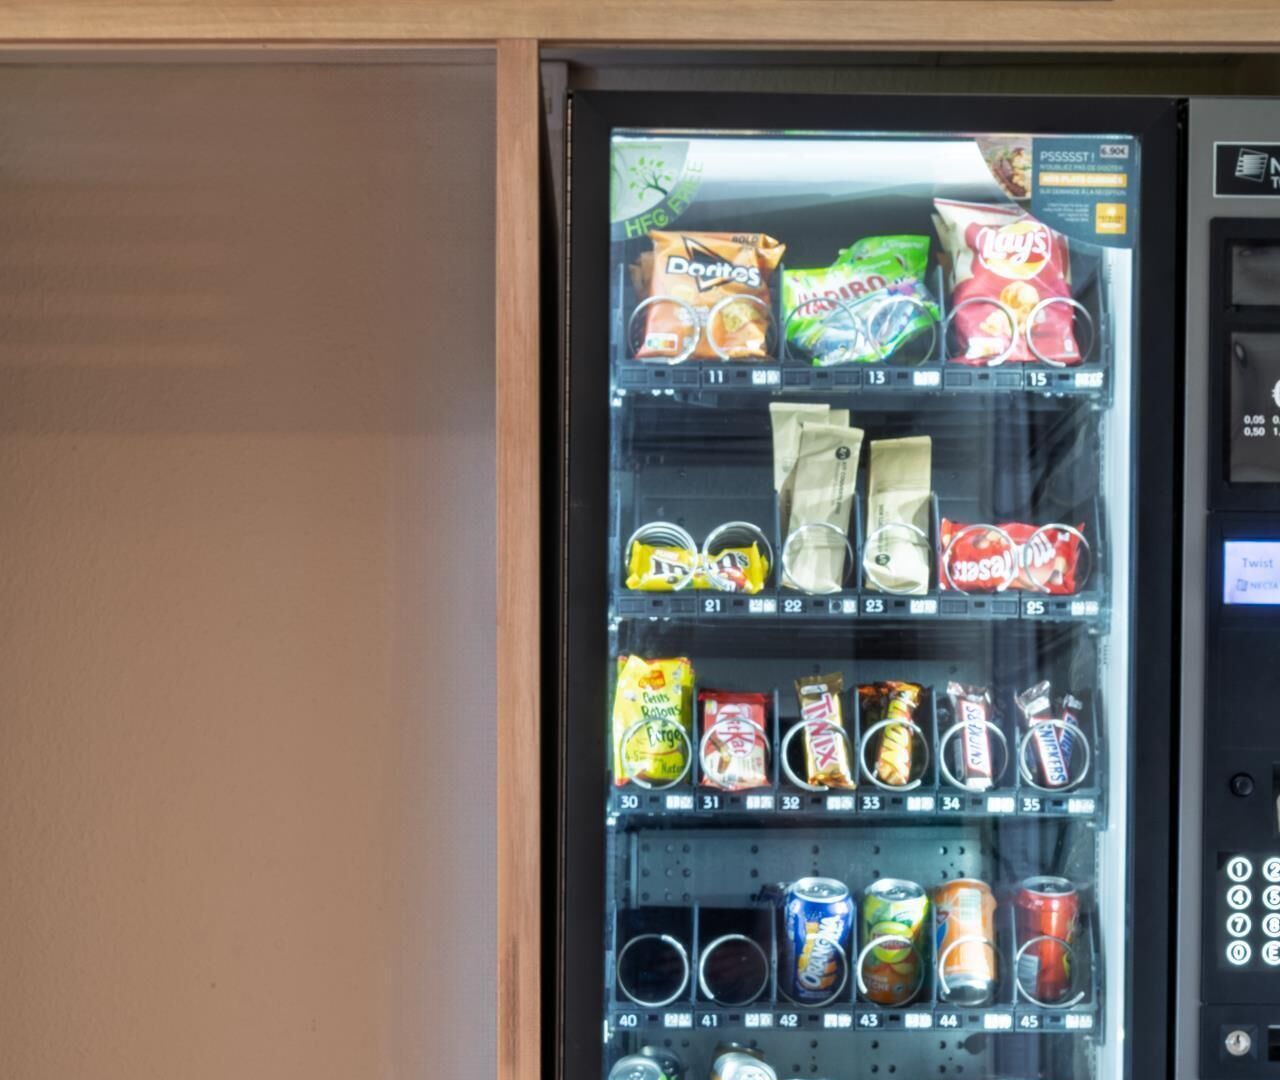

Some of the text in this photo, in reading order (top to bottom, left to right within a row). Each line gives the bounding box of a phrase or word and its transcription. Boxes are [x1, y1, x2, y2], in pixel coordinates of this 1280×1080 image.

[666, 255, 762, 288] Doritos
[796, 274, 887, 316] HARIBO
[709, 369, 723, 384] 11
[869, 370, 886, 385] 13
[1030, 372, 1047, 386] 15
[1242, 558, 1274, 569] Twist
[704, 599, 721, 612] 21
[784, 600, 802, 613] 22
[865, 600, 883, 613] 23
[1027, 601, 1045, 615] 25
[802, 693, 839, 768] TWIX
[621, 795, 638, 809] 30
[703, 795, 719, 809] 31
[782, 796, 800, 810] 32
[863, 796, 880, 810] 33
[943, 796, 960, 810] 34
[1023, 798, 1040, 812] 35
[619, 1014, 637, 1027] 40
[701, 1014, 718, 1027] 41
[780, 1014, 798, 1027] 42
[860, 1014, 878, 1027] 43
[939, 1015, 958, 1028] 44
[1021, 1015, 1039, 1028] 45
